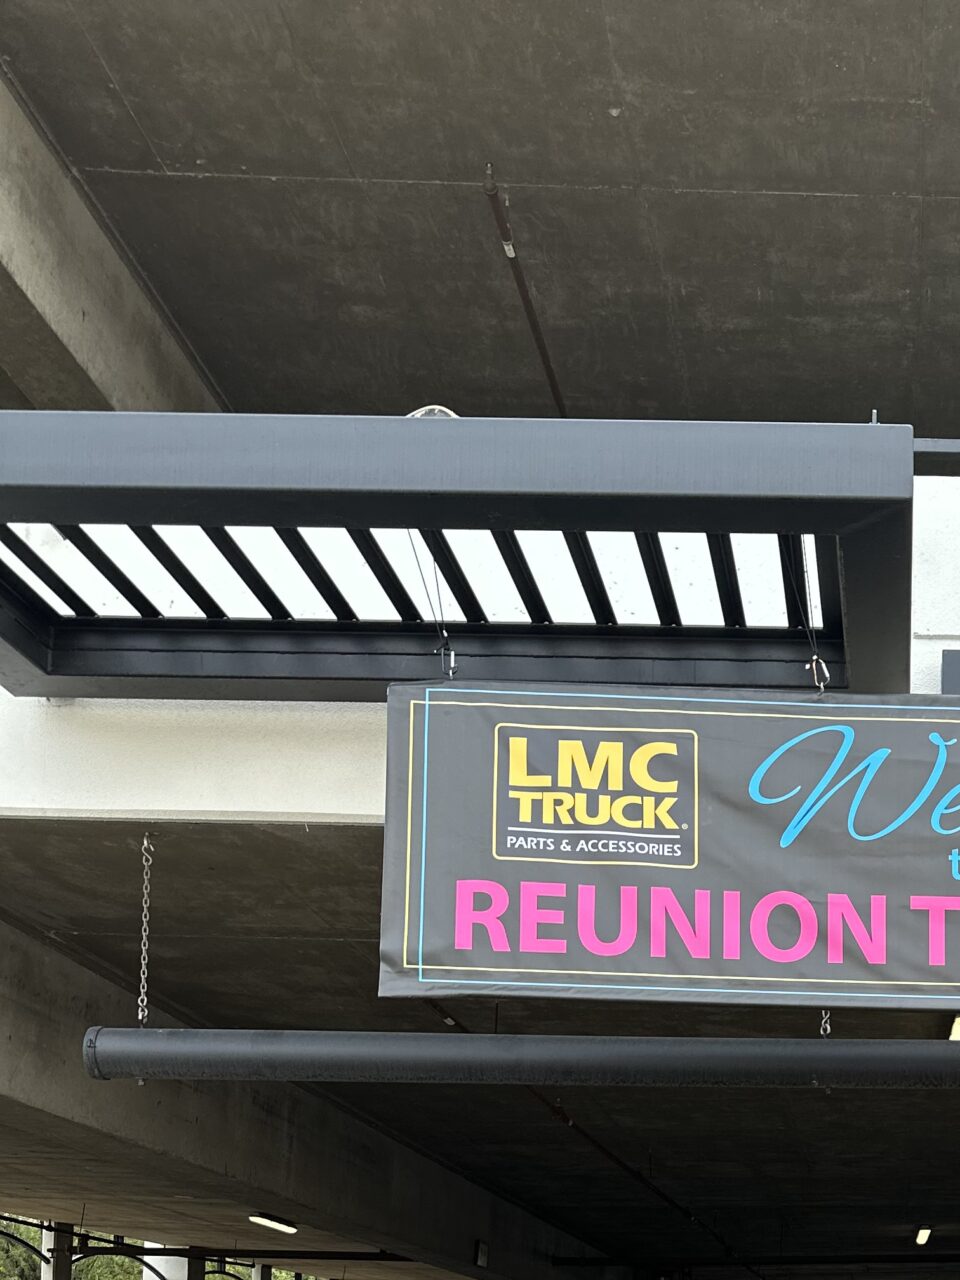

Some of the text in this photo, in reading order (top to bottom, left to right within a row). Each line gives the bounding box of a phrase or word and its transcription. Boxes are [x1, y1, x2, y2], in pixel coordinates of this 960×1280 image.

[508, 736, 679, 793] LMC
[506, 835, 682, 857] PARTS & ACCESSORIES
[453, 878, 888, 967] REUNION
